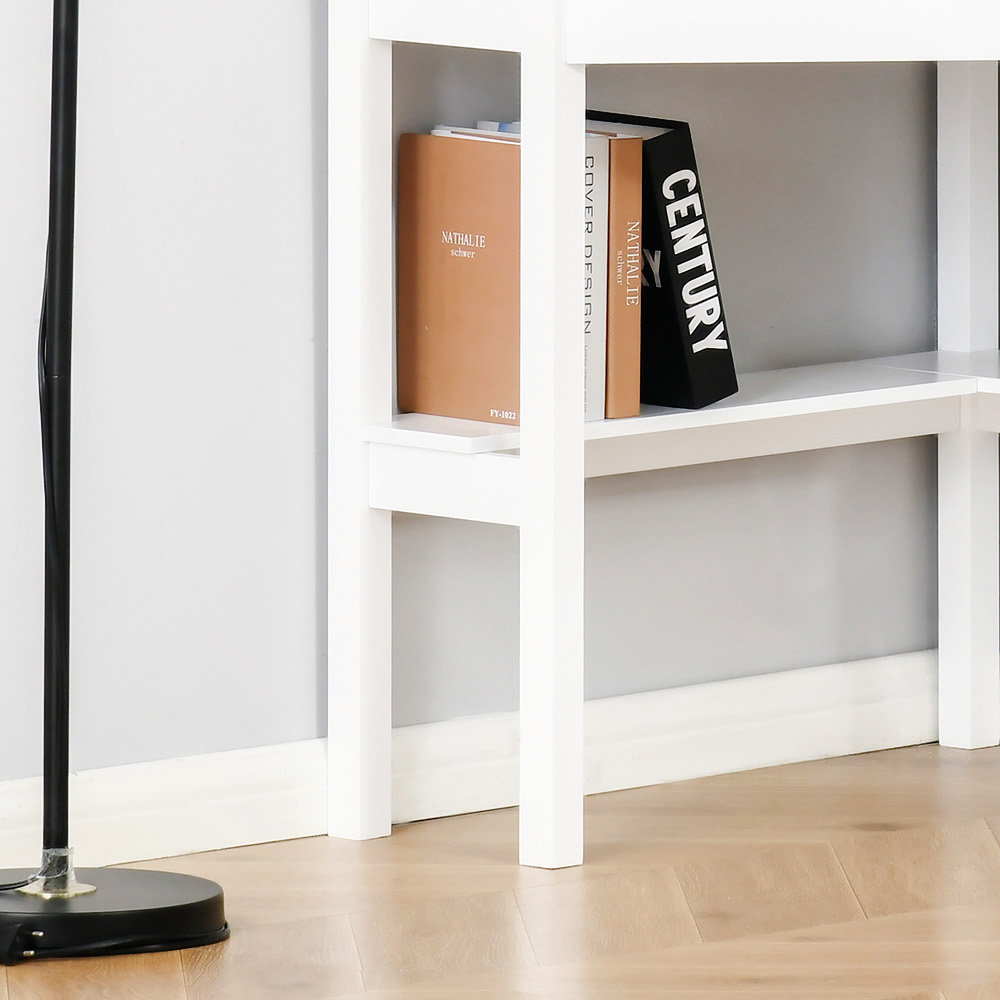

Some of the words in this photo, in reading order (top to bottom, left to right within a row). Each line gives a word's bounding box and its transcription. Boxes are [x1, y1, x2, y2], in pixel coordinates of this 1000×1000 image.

[585, 156, 594, 234] COVER
[441, 230, 486, 248] NATHALIE
[626, 221, 640, 306] NATHALIE
[661, 169, 728, 354] CENTURY
[490, 408, 517, 420] FY-1022
